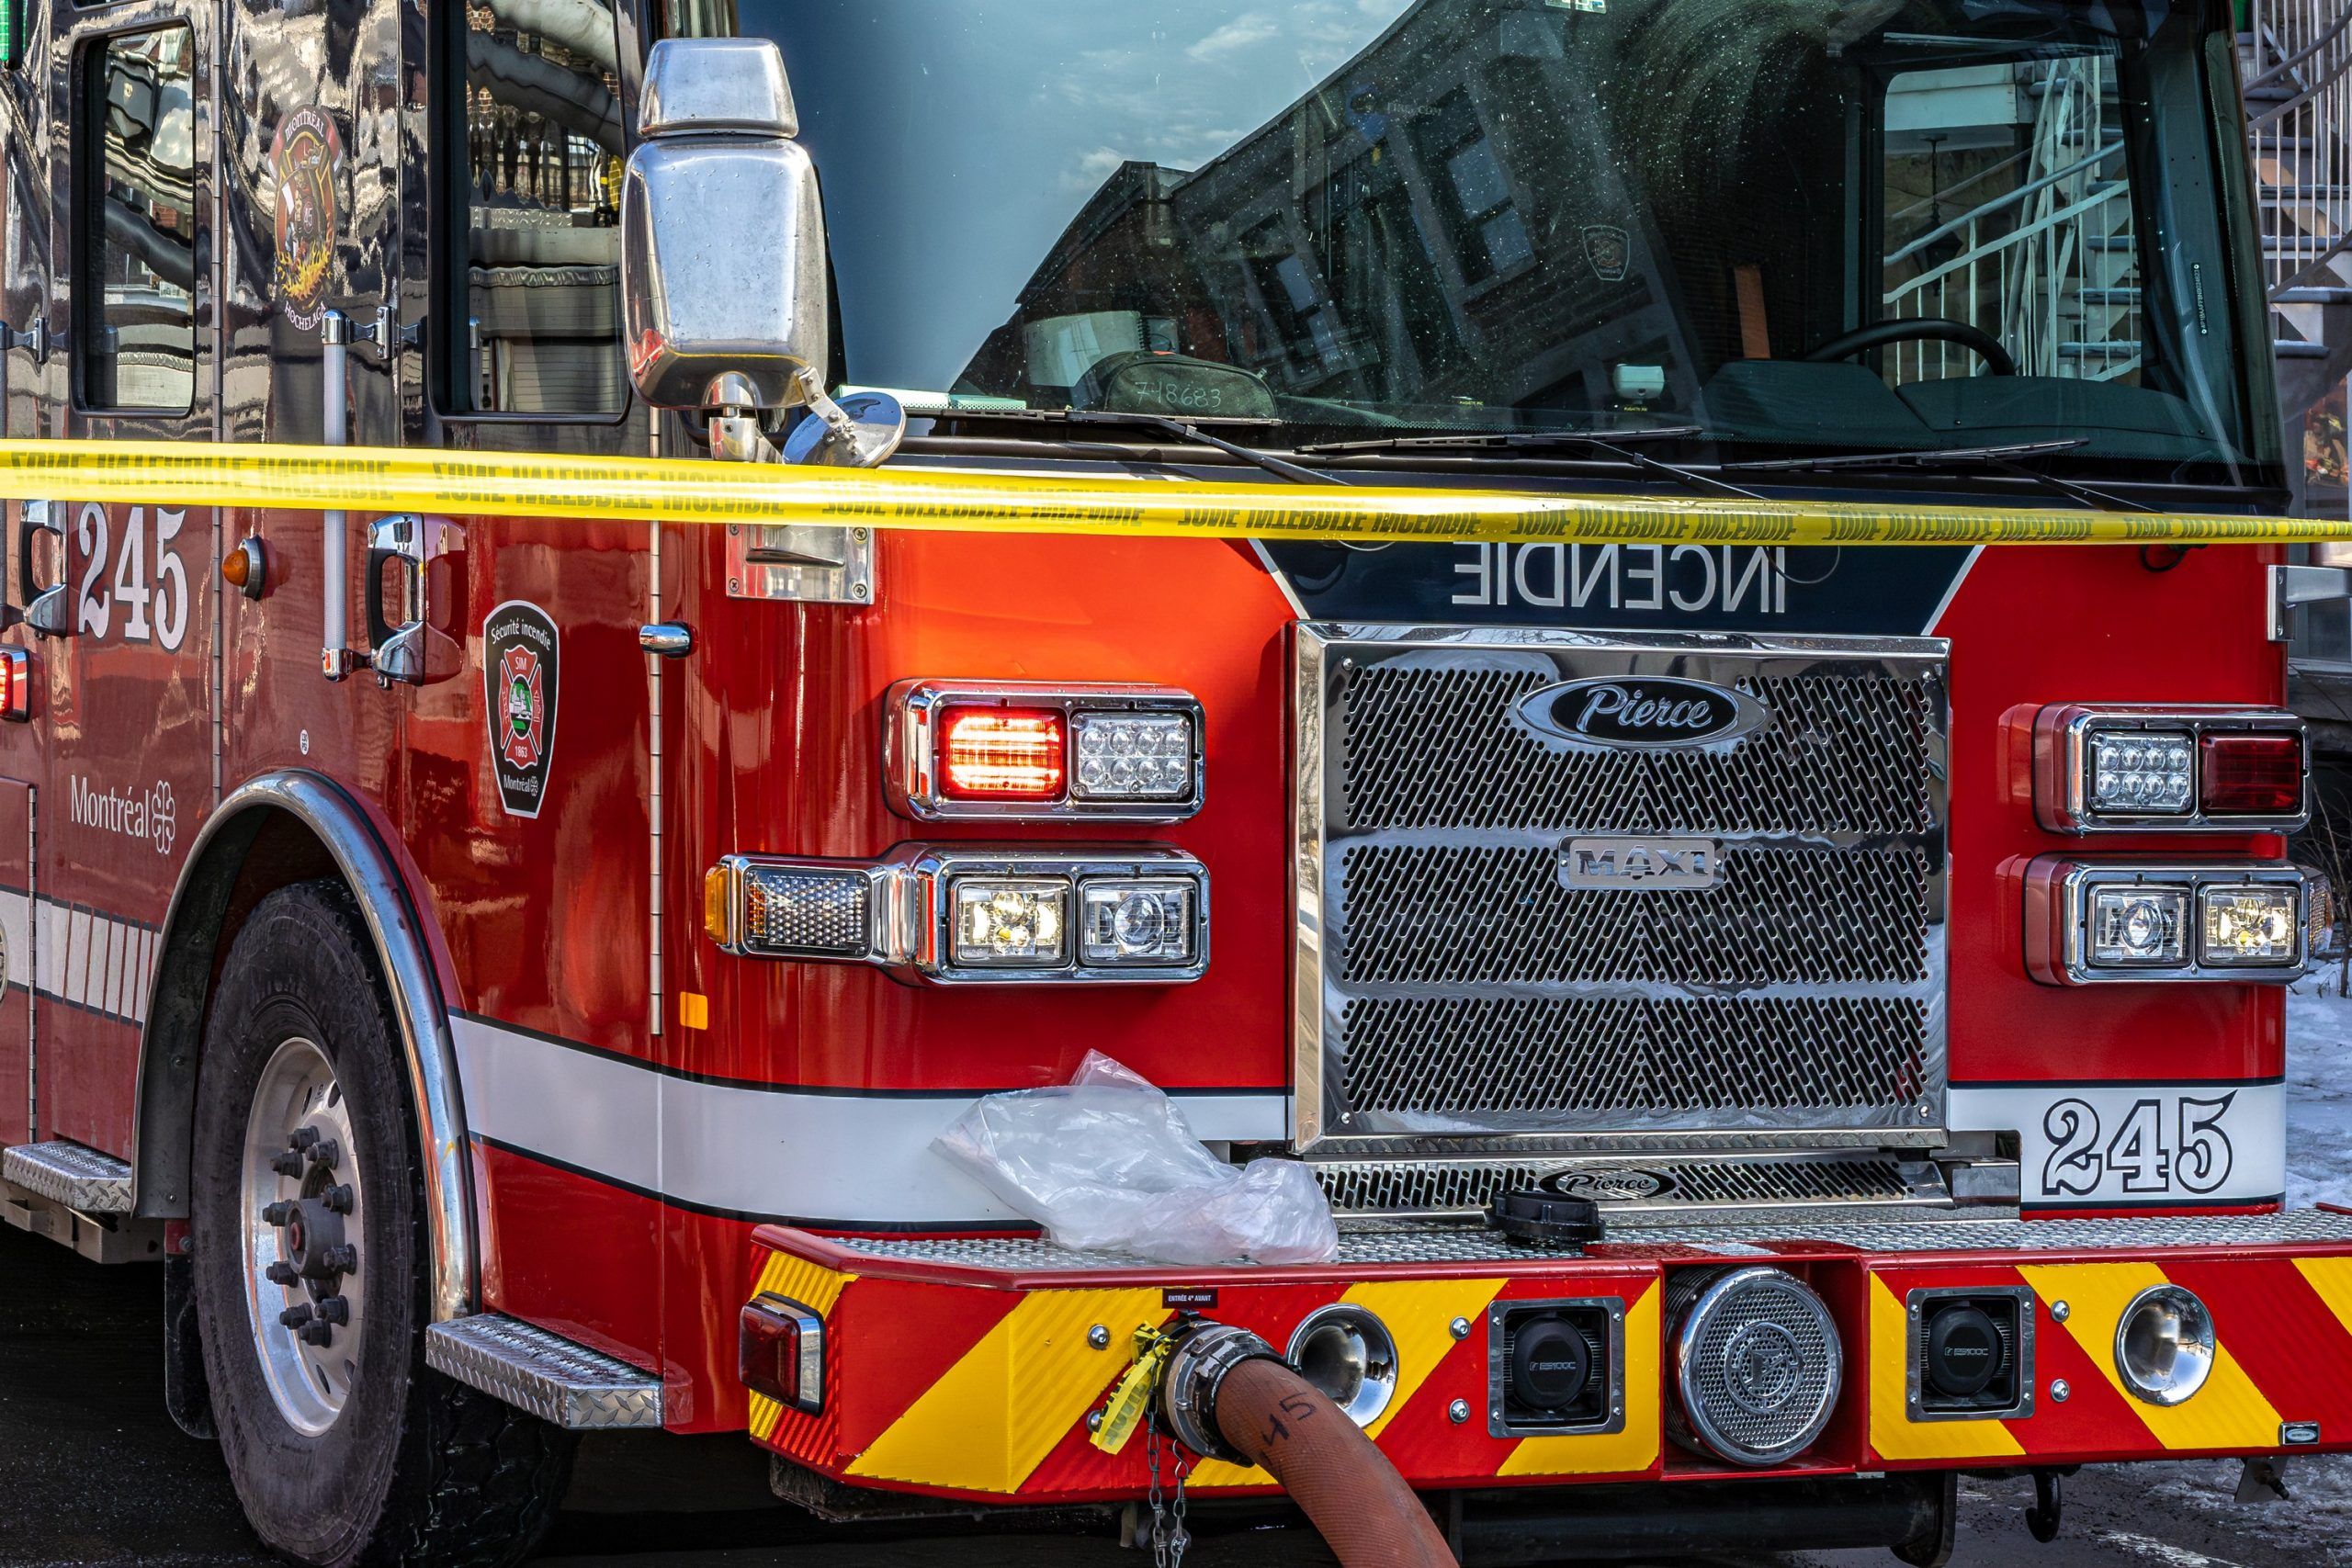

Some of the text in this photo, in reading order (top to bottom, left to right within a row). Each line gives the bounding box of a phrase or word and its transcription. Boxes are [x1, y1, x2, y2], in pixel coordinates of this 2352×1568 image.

[284, 299, 326, 332] HOCHELAGA
[78, 501, 188, 653] 245
[491, 616, 552, 651] Sécurité incendie
[514, 655, 528, 671] SIM
[1575, 683, 1713, 733] Pierce
[514, 744, 528, 759] 1863
[503, 773, 531, 793] Montréal
[71, 774, 149, 838] Montréal
[1575, 844, 1708, 879] MAXI
[2041, 1089, 2238, 1196] 245
[1565, 1173, 1653, 1192] Pierce
[1168, 1292, 1187, 1302] ENTRÉE
